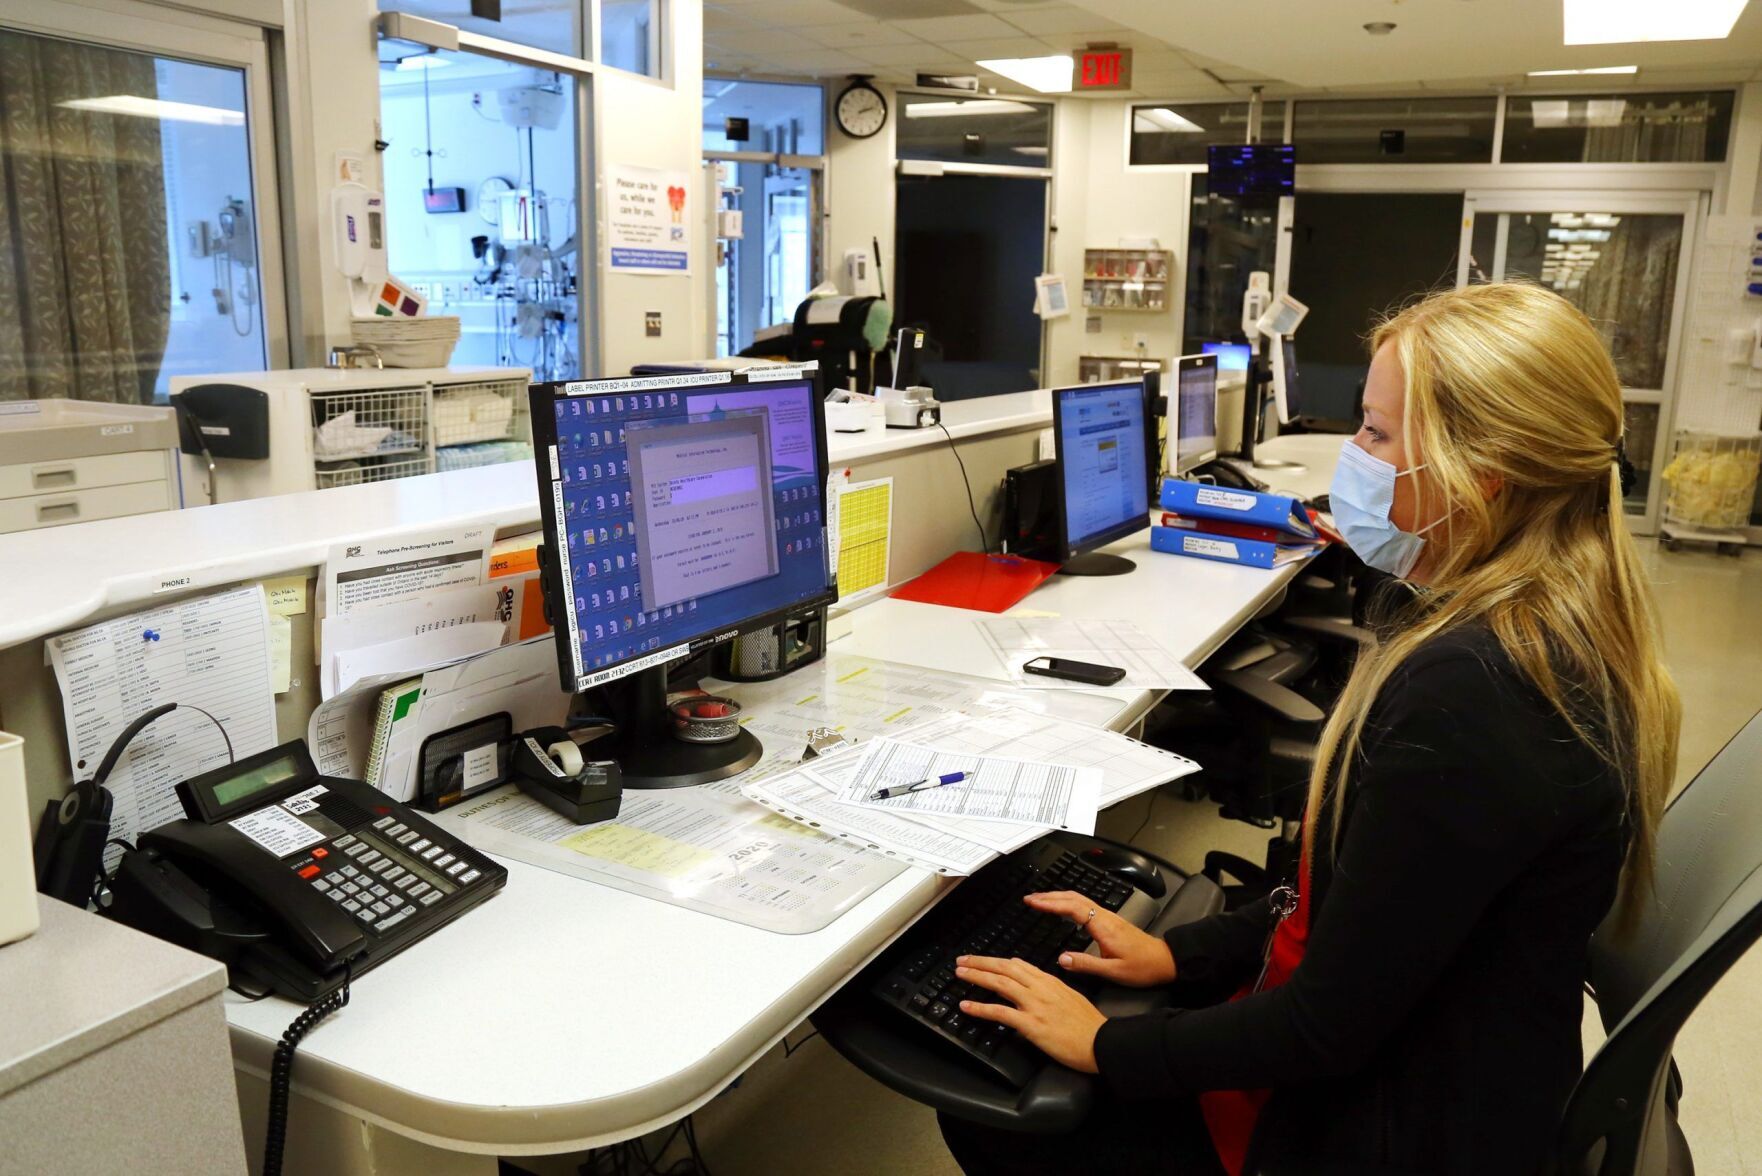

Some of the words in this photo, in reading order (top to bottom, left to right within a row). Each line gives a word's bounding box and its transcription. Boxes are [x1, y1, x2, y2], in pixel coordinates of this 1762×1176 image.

[1081, 53, 1121, 86] EXIT
[616, 178, 635, 188] Please
[630, 193, 645, 203] while
[620, 206, 632, 214] care
[633, 206, 642, 215] for
[568, 384, 584, 392] LABEL
[586, 383, 608, 391] PRINTER
[401, 542, 431, 551] Pre-Screening
[396, 564, 417, 572] Screening
[162, 578, 185, 588] PHONE
[564, 569, 573, 605] password
[574, 638, 582, 674] username
[458, 801, 497, 818] DUTIES
[728, 841, 768, 860] 2020
